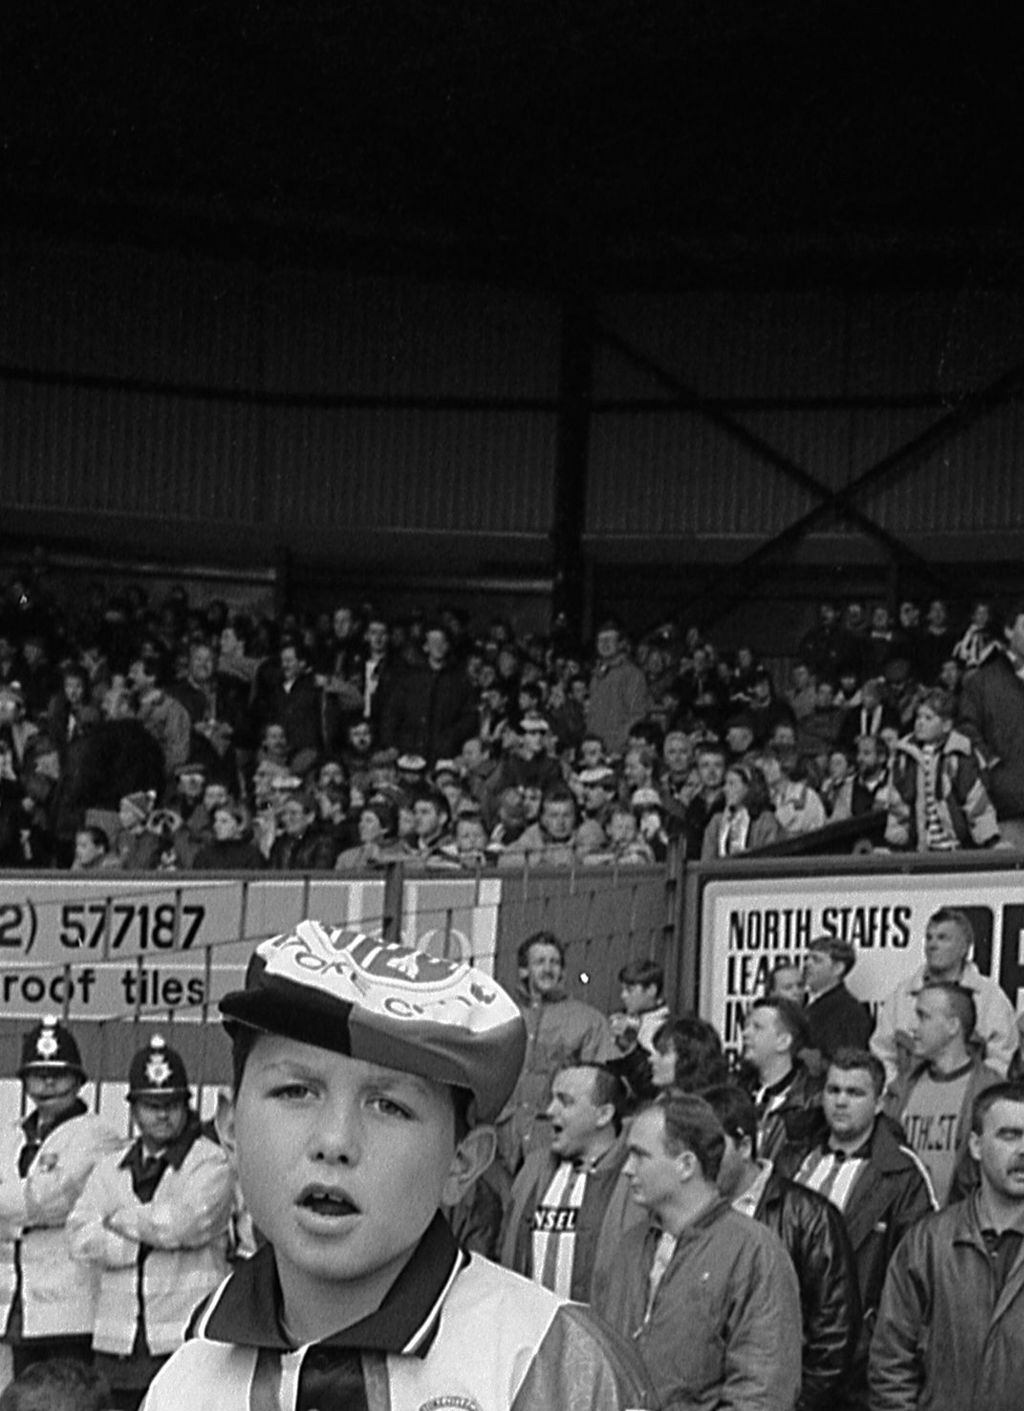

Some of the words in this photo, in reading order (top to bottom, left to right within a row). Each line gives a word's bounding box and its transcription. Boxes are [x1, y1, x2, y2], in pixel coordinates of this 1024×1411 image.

[60, 904, 206, 950] 577187
[729, 909, 812, 951] NORTH
[821, 906, 912, 949] STAFFS
[4, 968, 96, 1004] roof
[122, 969, 206, 1005] tiles
